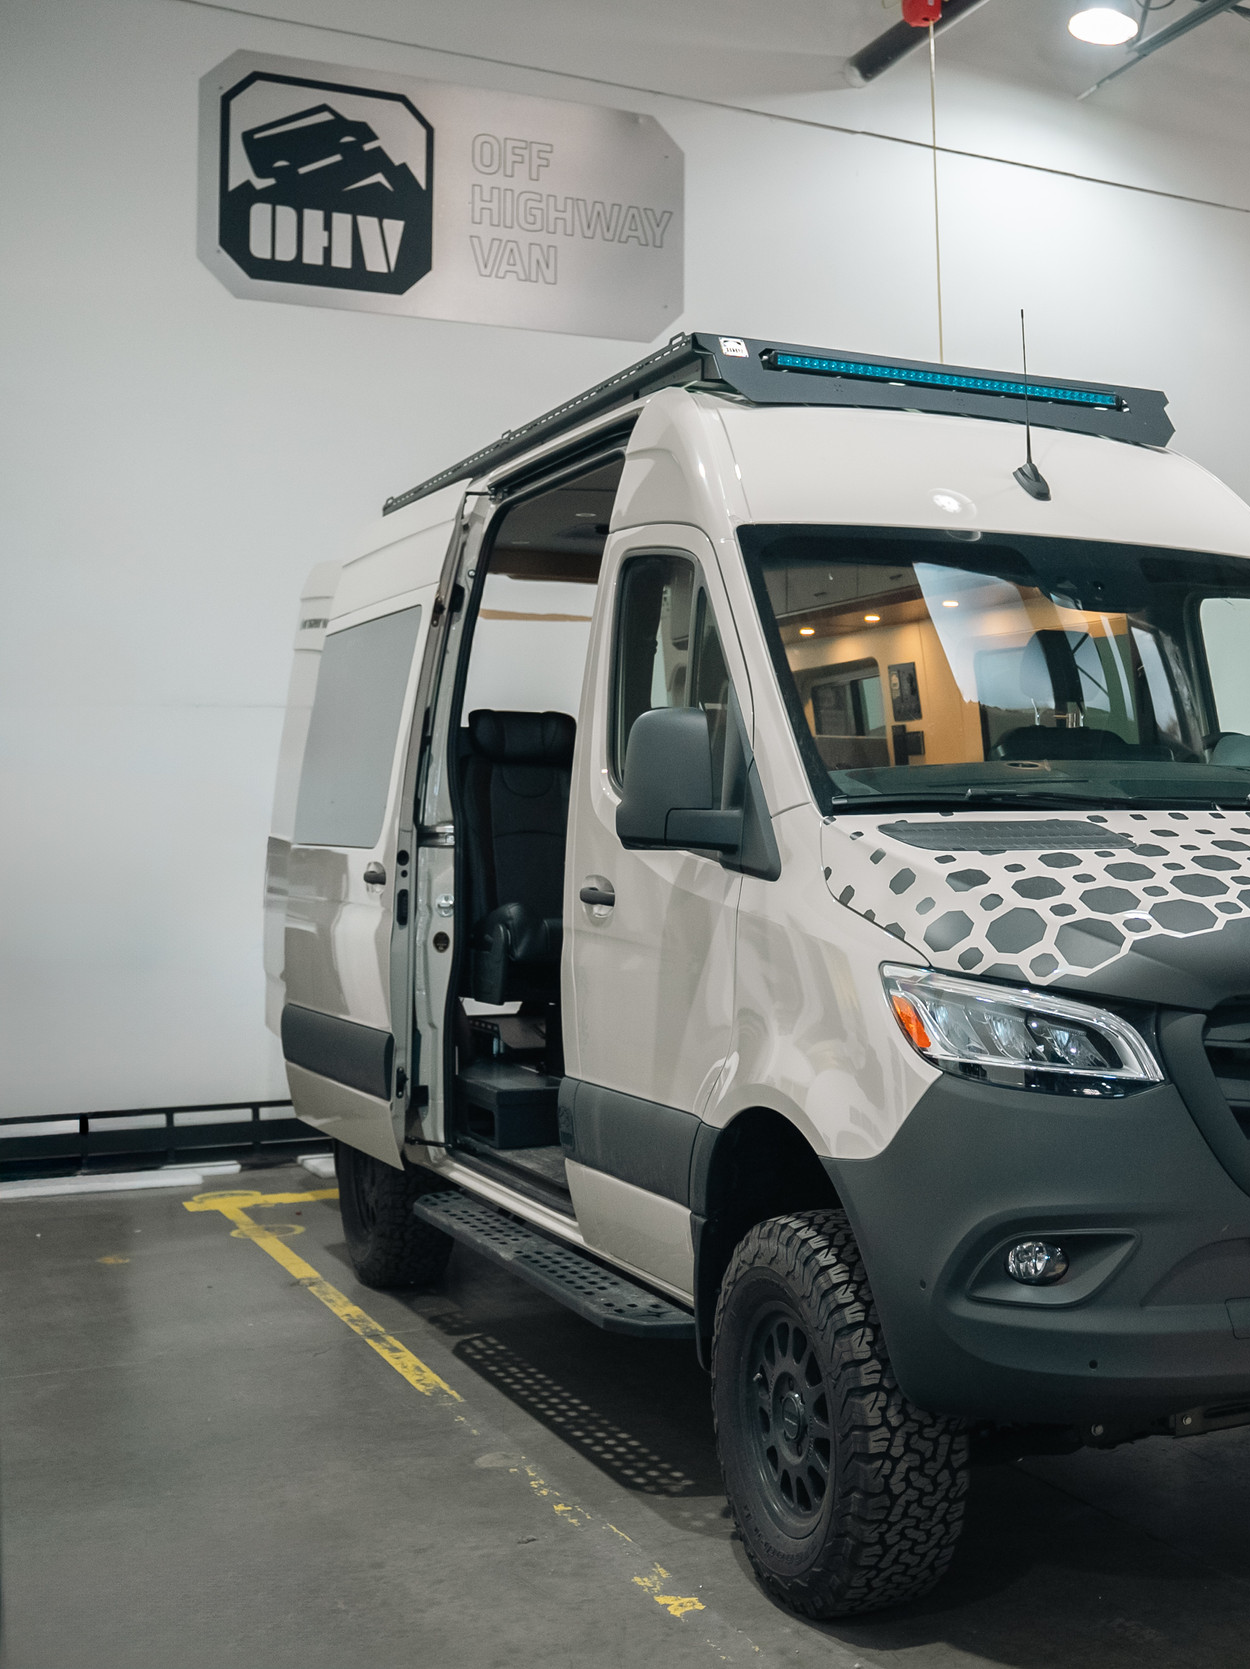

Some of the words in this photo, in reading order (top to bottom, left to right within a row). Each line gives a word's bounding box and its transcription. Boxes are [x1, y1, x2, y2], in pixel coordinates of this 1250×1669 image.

[471, 133, 554, 181] OFF
[249, 202, 406, 274] OHV
[471, 183, 674, 249] HIGHWAY
[469, 235, 558, 285] VAN
